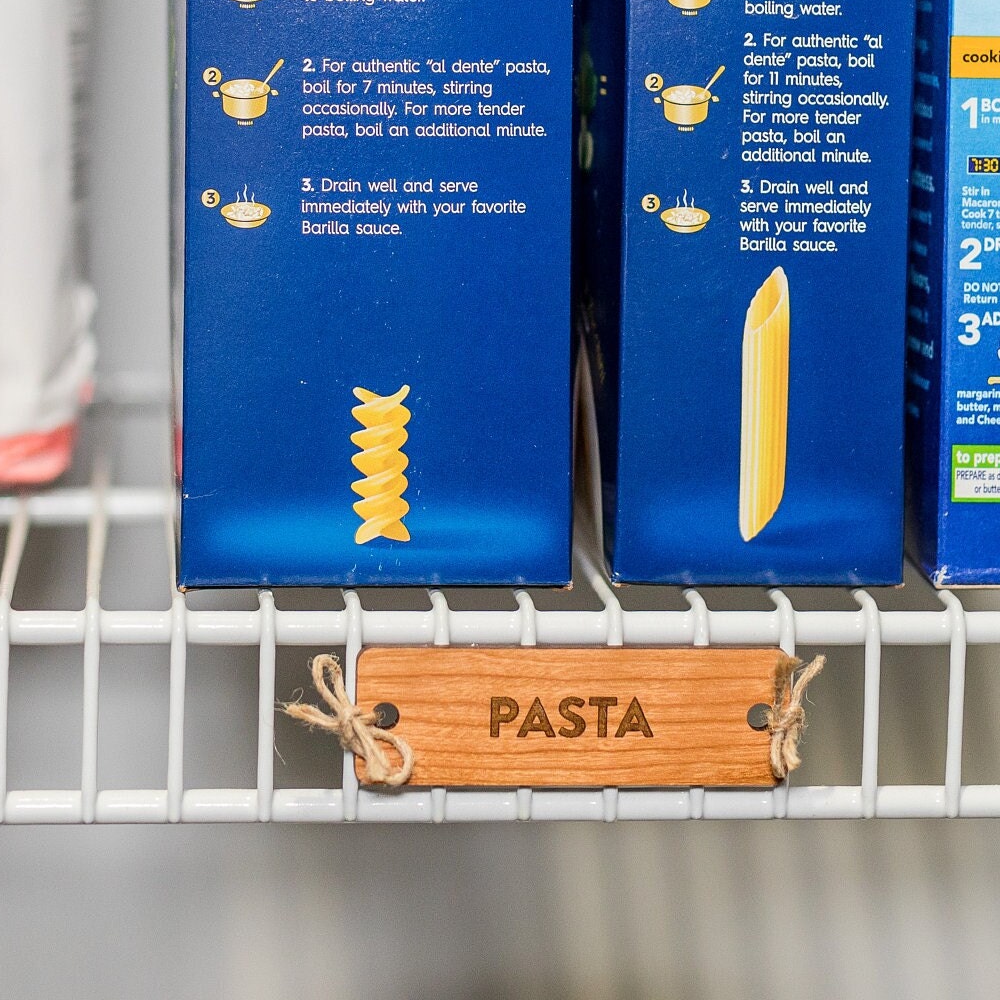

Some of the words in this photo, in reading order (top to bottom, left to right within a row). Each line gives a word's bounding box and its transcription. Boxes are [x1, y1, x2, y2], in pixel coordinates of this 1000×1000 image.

[744, 0, 794, 18] boiling
[799, 1, 843, 16] water.
[743, 32, 757, 47] 2.
[763, 32, 787, 48] For
[791, 33, 859, 49] authentic
[302, 57, 316, 73] 2.
[321, 58, 347, 73] For
[351, 58, 421, 74] authentic
[505, 59, 551, 77] pasta,
[796, 52, 842, 70] pasta,
[848, 53, 876, 68] boil
[742, 70, 765, 86] for
[769, 71, 779, 86] 11
[785, 71, 843, 88] minutes,
[302, 79, 331, 94] boil
[335, 79, 358, 94] for
[362, 79, 373, 94] 7
[377, 80, 437, 97] minutes,
[442, 80, 493, 98] stirring
[742, 89, 792, 108] stirring
[797, 91, 889, 109] occasionally.
[302, 101, 398, 119] occasionally.
[404, 101, 429, 116] For
[434, 104, 472, 116] more
[477, 101, 526, 116] tender
[742, 108, 767, 124] For
[771, 112, 810, 125] more
[814, 109, 862, 125] tender
[960, 97, 978, 129] 1
[302, 122, 349, 140] pasta,
[355, 121, 384, 137] boil
[388, 125, 409, 137] an
[415, 122, 491, 137] additional
[496, 122, 547, 137] minute.
[971, 157, 999, 173] 7:30
[301, 177, 315, 192] 3.
[321, 177, 362, 193] Drain
[367, 178, 398, 193] well
[402, 178, 434, 193] and
[439, 181, 479, 193] serve
[961, 185, 979, 196] Stir
[981, 185, 990, 196] in
[301, 199, 392, 217] immediately
[396, 199, 428, 214] with
[432, 202, 466, 217] your
[471, 199, 527, 214] favorite
[961, 208, 986, 219] Cook
[988, 209, 994, 219] 7
[302, 220, 350, 235] Barilla
[355, 223, 402, 235] sauce.
[960, 237, 982, 270] 2
[963, 282, 980, 293] DO
[963, 293, 998, 304] Return
[958, 312, 981, 346] 3
[956, 401, 990, 413] butter,
[956, 415, 975, 425] and
[956, 450, 970, 464] to
[956, 470, 986, 481] PREPARE
[490, 696, 653, 738] PASTA
